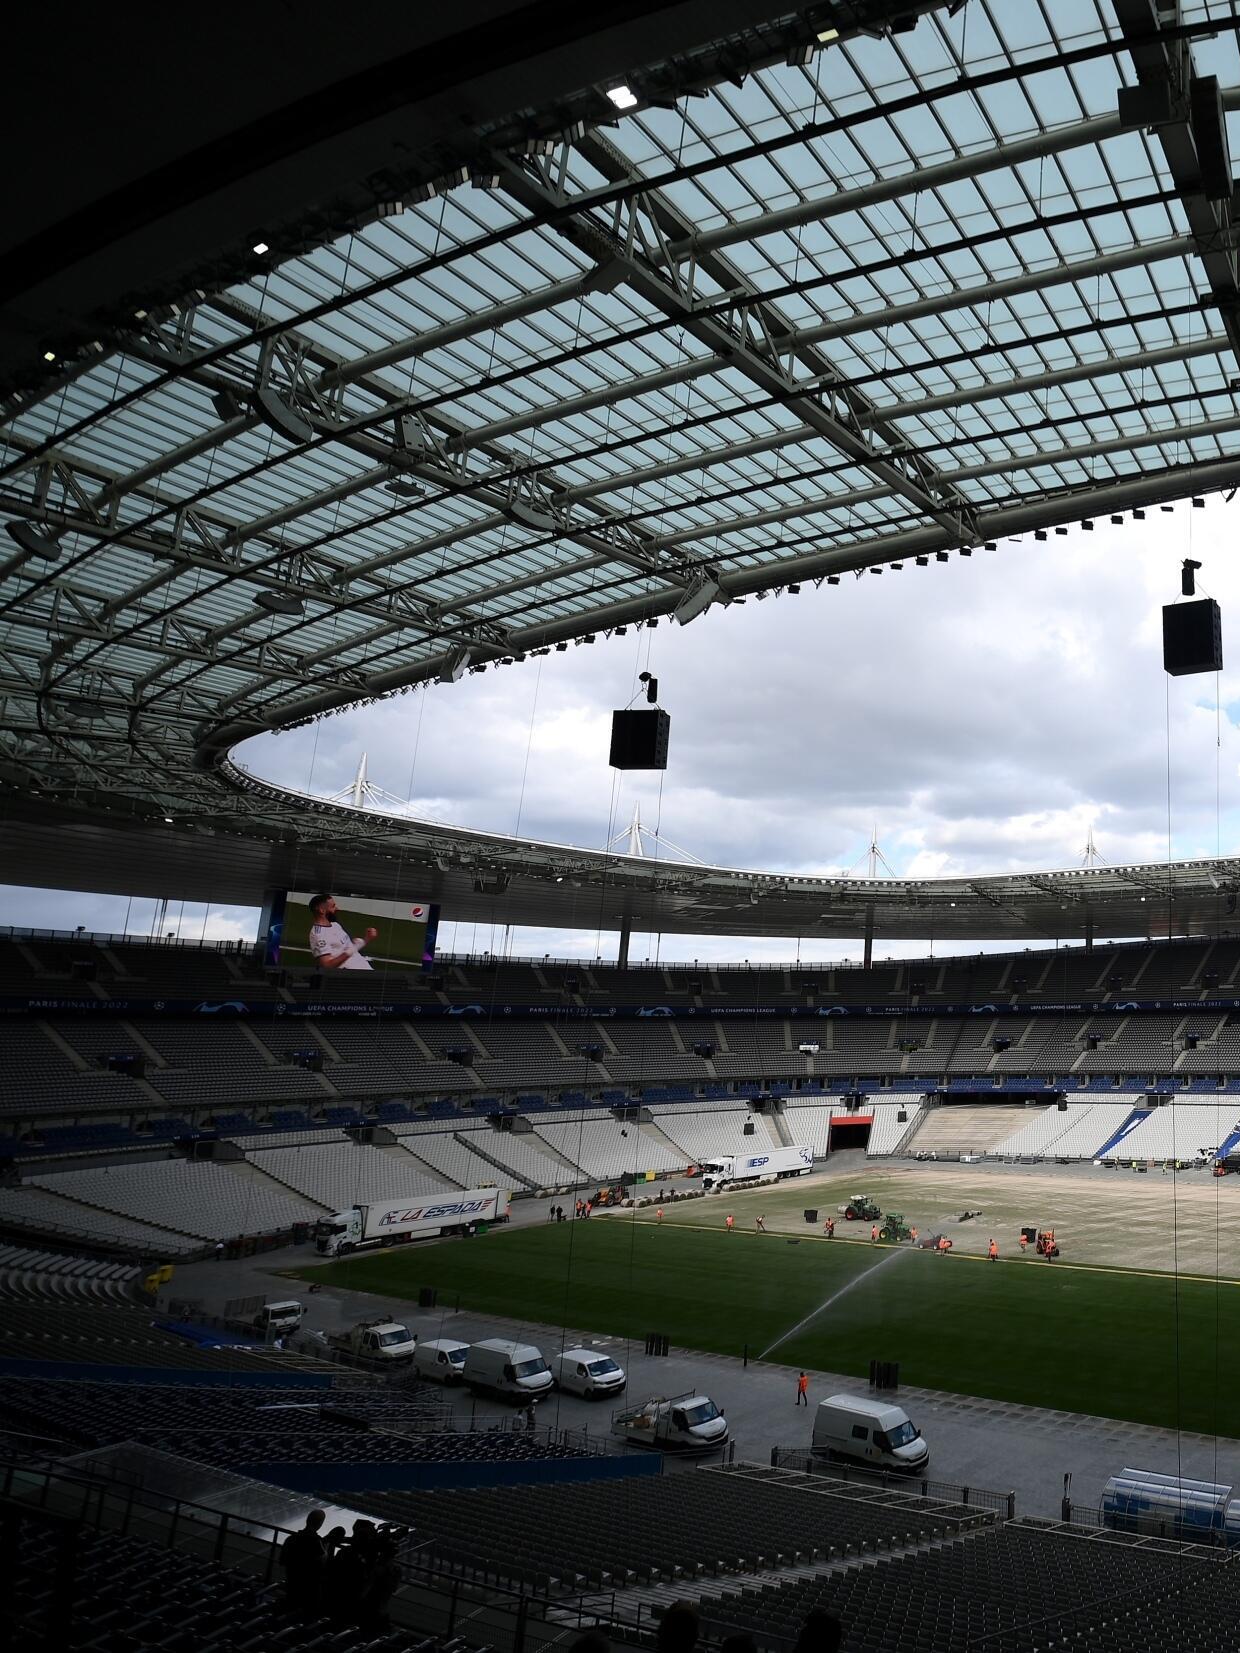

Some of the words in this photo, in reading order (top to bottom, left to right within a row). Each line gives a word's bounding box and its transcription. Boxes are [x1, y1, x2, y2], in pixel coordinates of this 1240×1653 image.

[752, 1157, 769, 1166] ESP
[401, 1209, 423, 1222] LA
[423, 1201, 482, 1218] ESPADA
